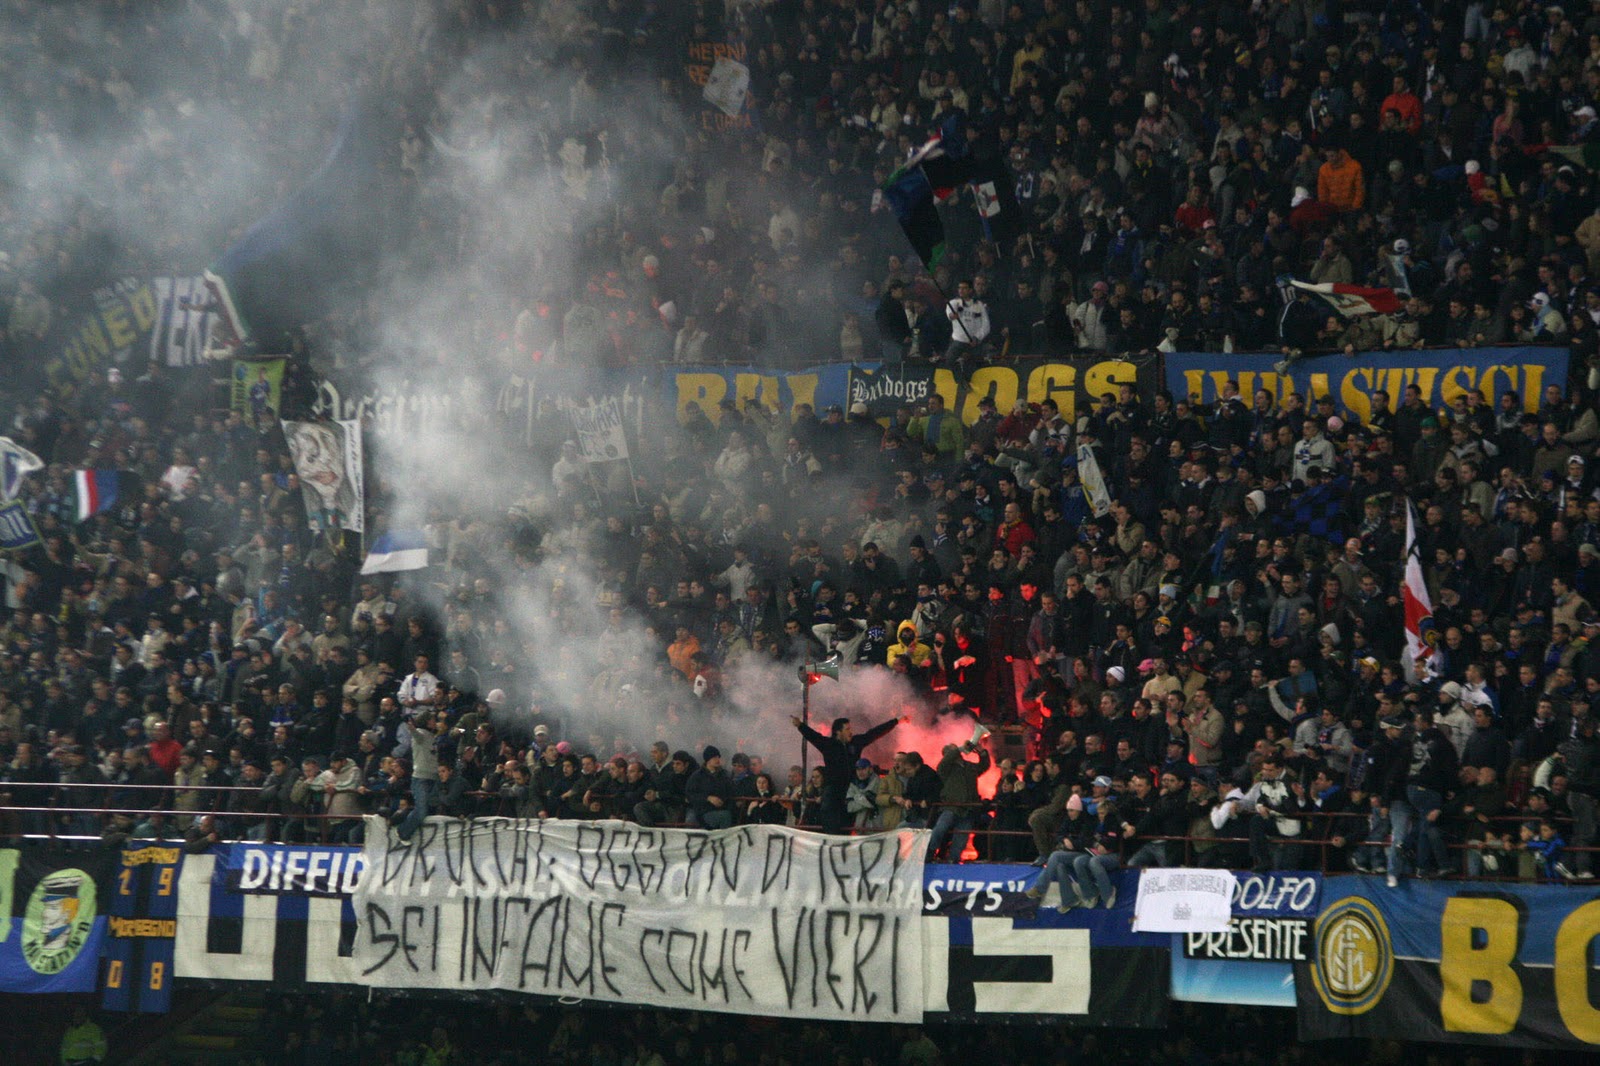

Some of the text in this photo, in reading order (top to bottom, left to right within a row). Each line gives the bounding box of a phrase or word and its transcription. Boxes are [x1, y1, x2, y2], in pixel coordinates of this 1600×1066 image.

[852, 374, 929, 403] Buldogs
[576, 825, 667, 896] OGGI
[761, 833, 795, 895] DI
[818, 837, 901, 904] IERI
[362, 895, 900, 1015] SEI INFAME COME VIERI
[1186, 917, 1309, 961] PRESENTE
